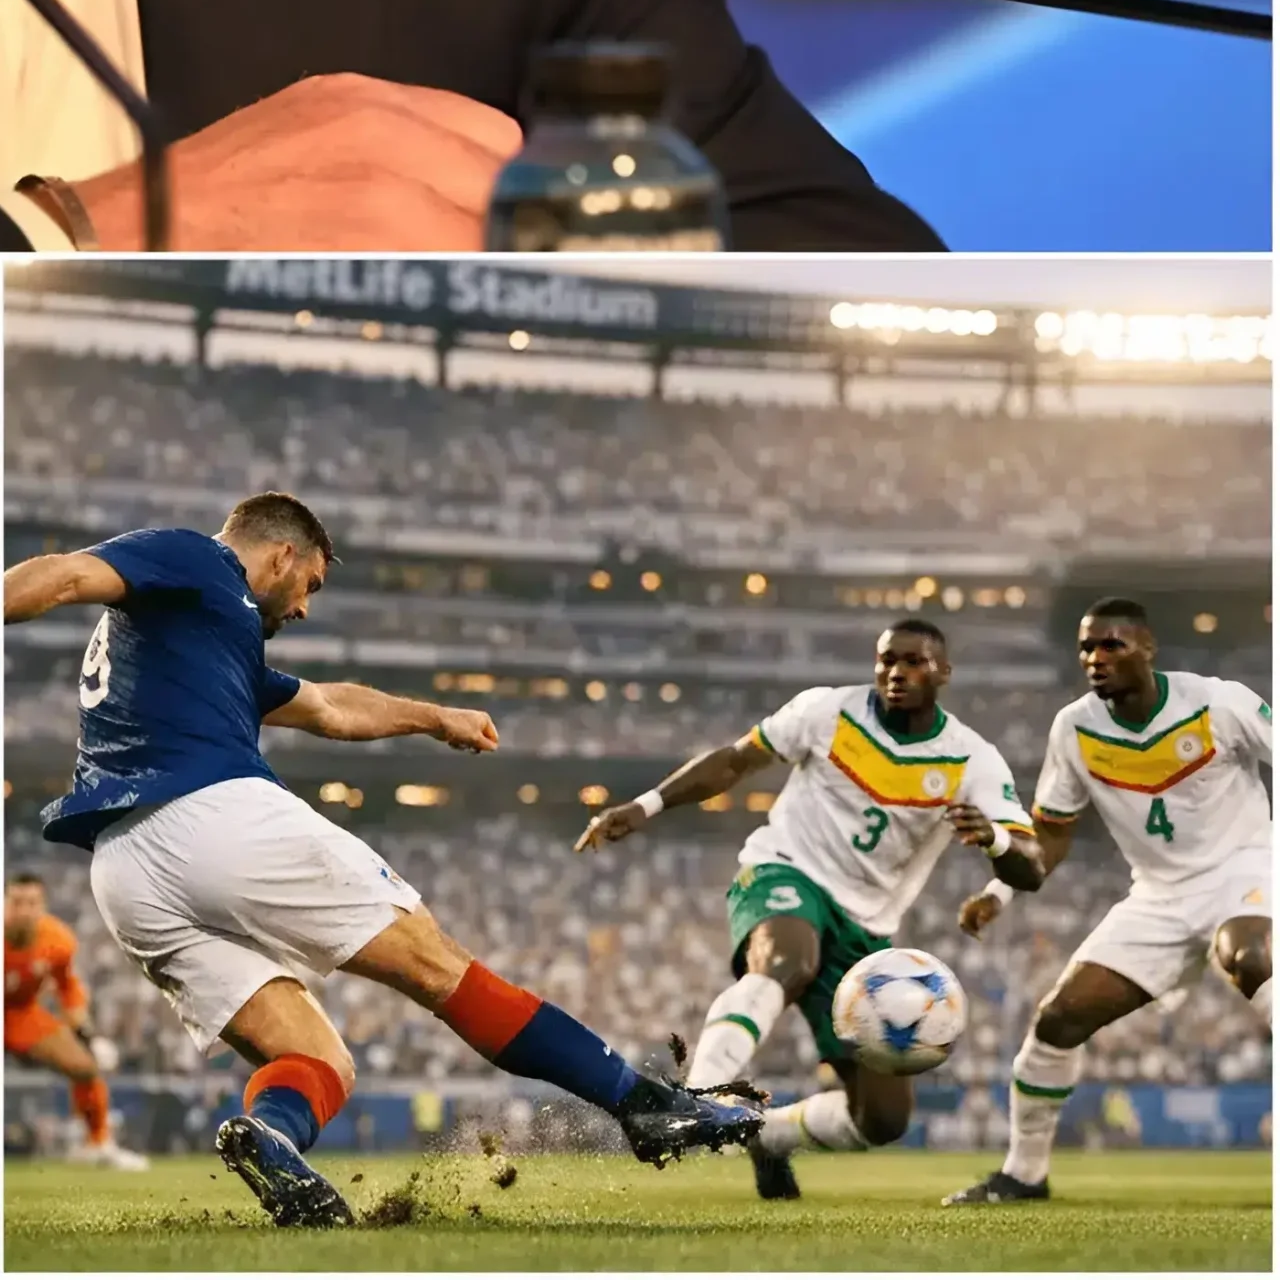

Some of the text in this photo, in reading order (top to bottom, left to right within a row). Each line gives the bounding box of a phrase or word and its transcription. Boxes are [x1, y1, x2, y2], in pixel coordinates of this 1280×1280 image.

[447, 261, 658, 329] Stadium
[852, 806, 888, 852] 3
[1145, 797, 1174, 842] 4
